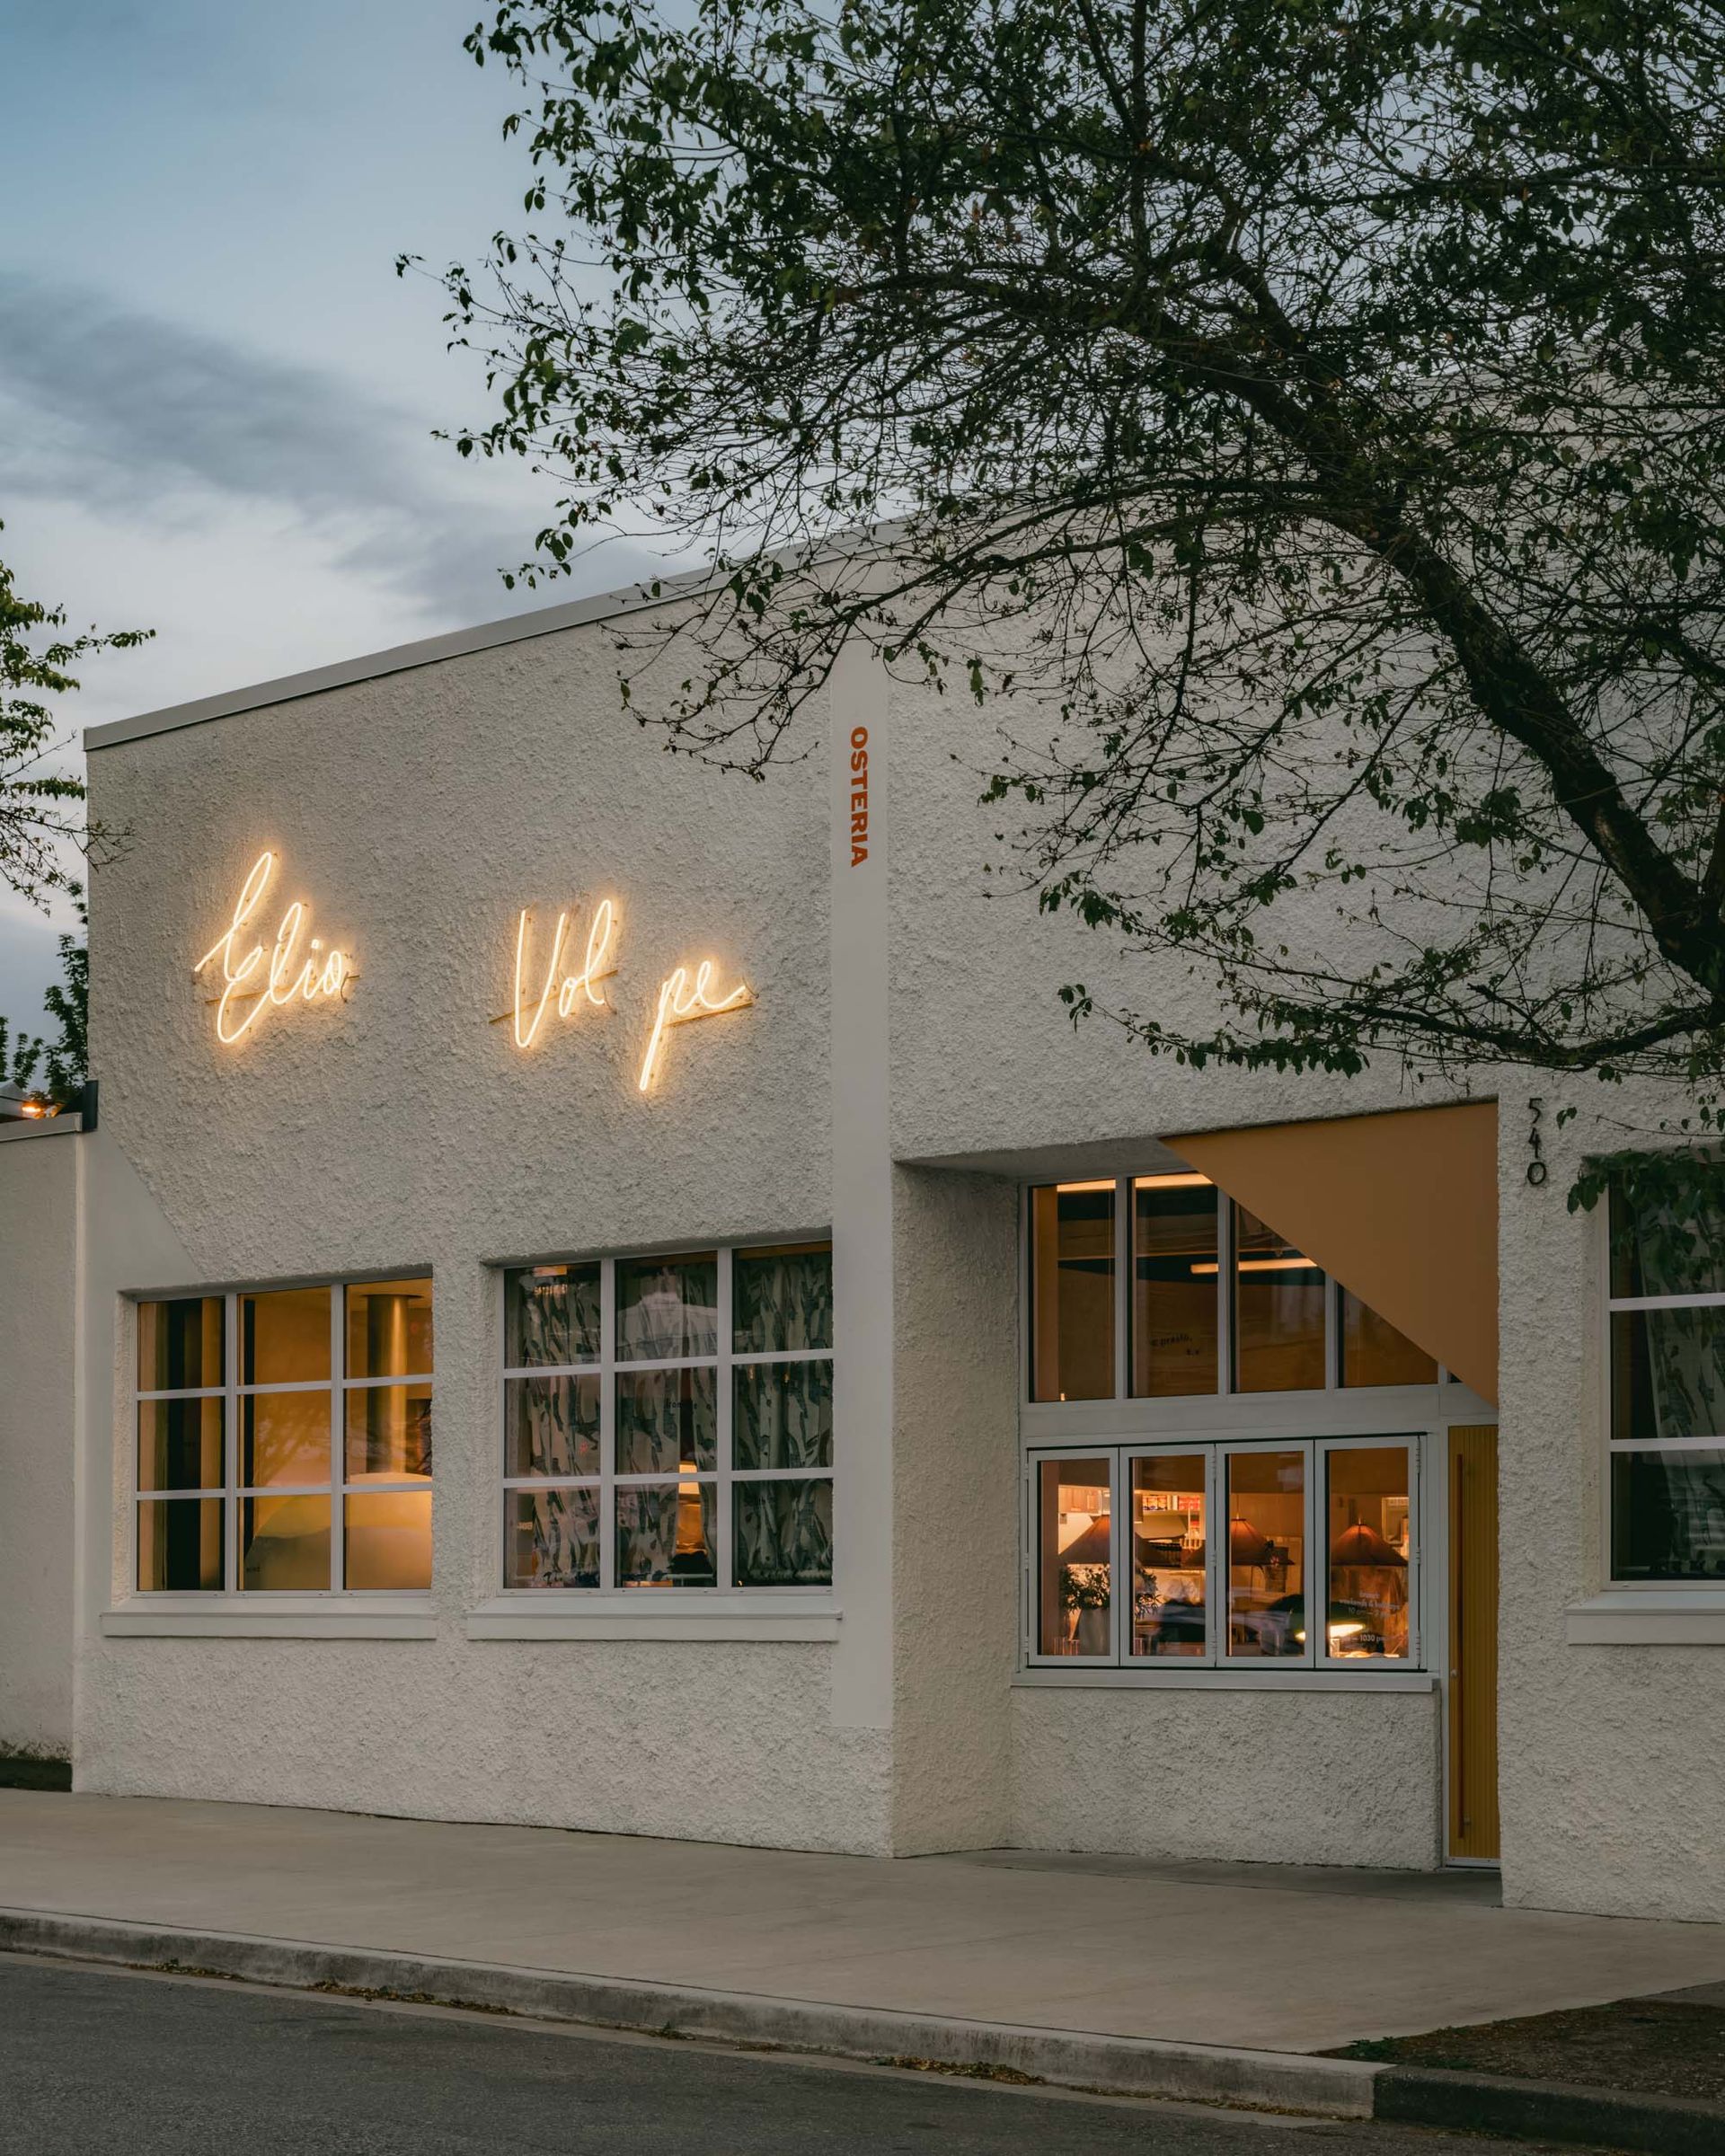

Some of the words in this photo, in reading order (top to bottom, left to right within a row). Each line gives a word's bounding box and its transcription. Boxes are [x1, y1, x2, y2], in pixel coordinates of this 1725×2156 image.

[850, 726, 869, 868] OSTERIA
[194, 852, 344, 1043] Elio
[1527, 1097, 1547, 1186] 540
